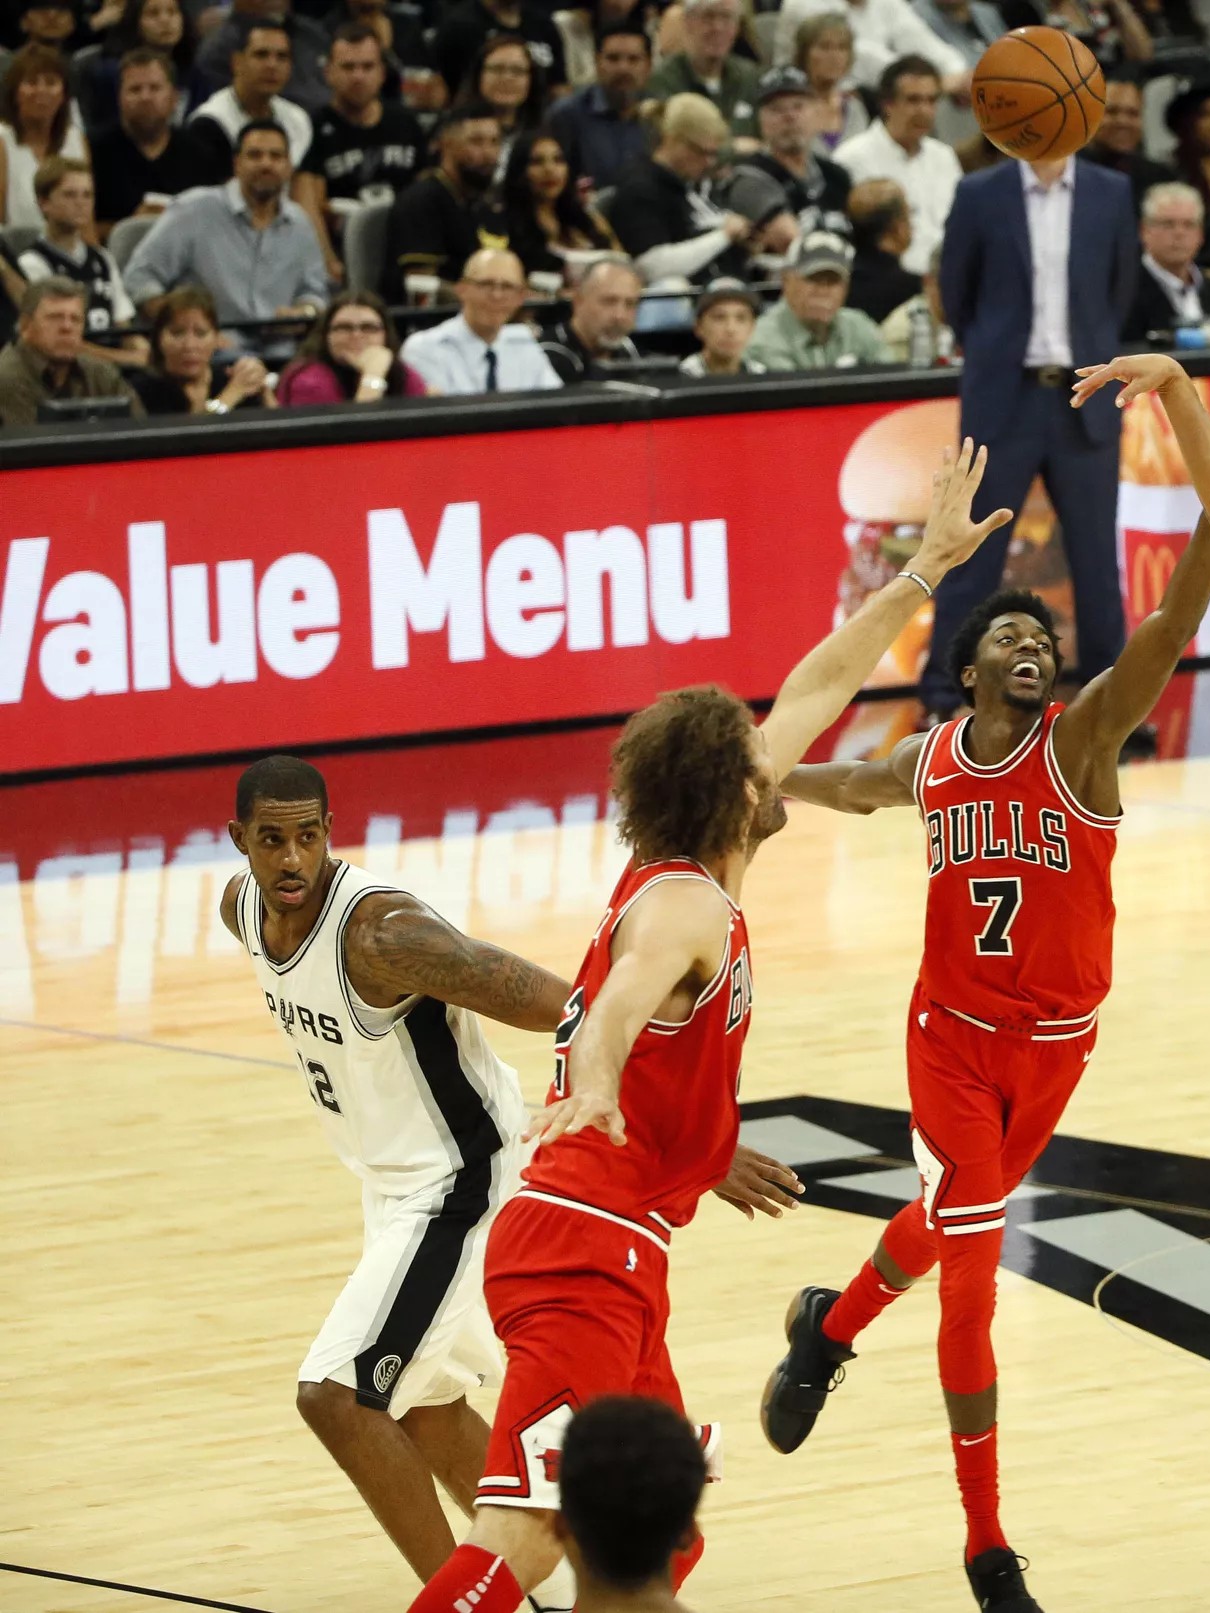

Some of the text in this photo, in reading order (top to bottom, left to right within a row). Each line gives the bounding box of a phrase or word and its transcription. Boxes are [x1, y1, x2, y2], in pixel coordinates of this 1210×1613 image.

[0, 501, 730, 704] Value Menu
[926, 801, 1072, 878] BULLS
[968, 876, 1023, 956] 7
[262, 988, 344, 1046] PURS
[297, 1050, 344, 1117] 2
